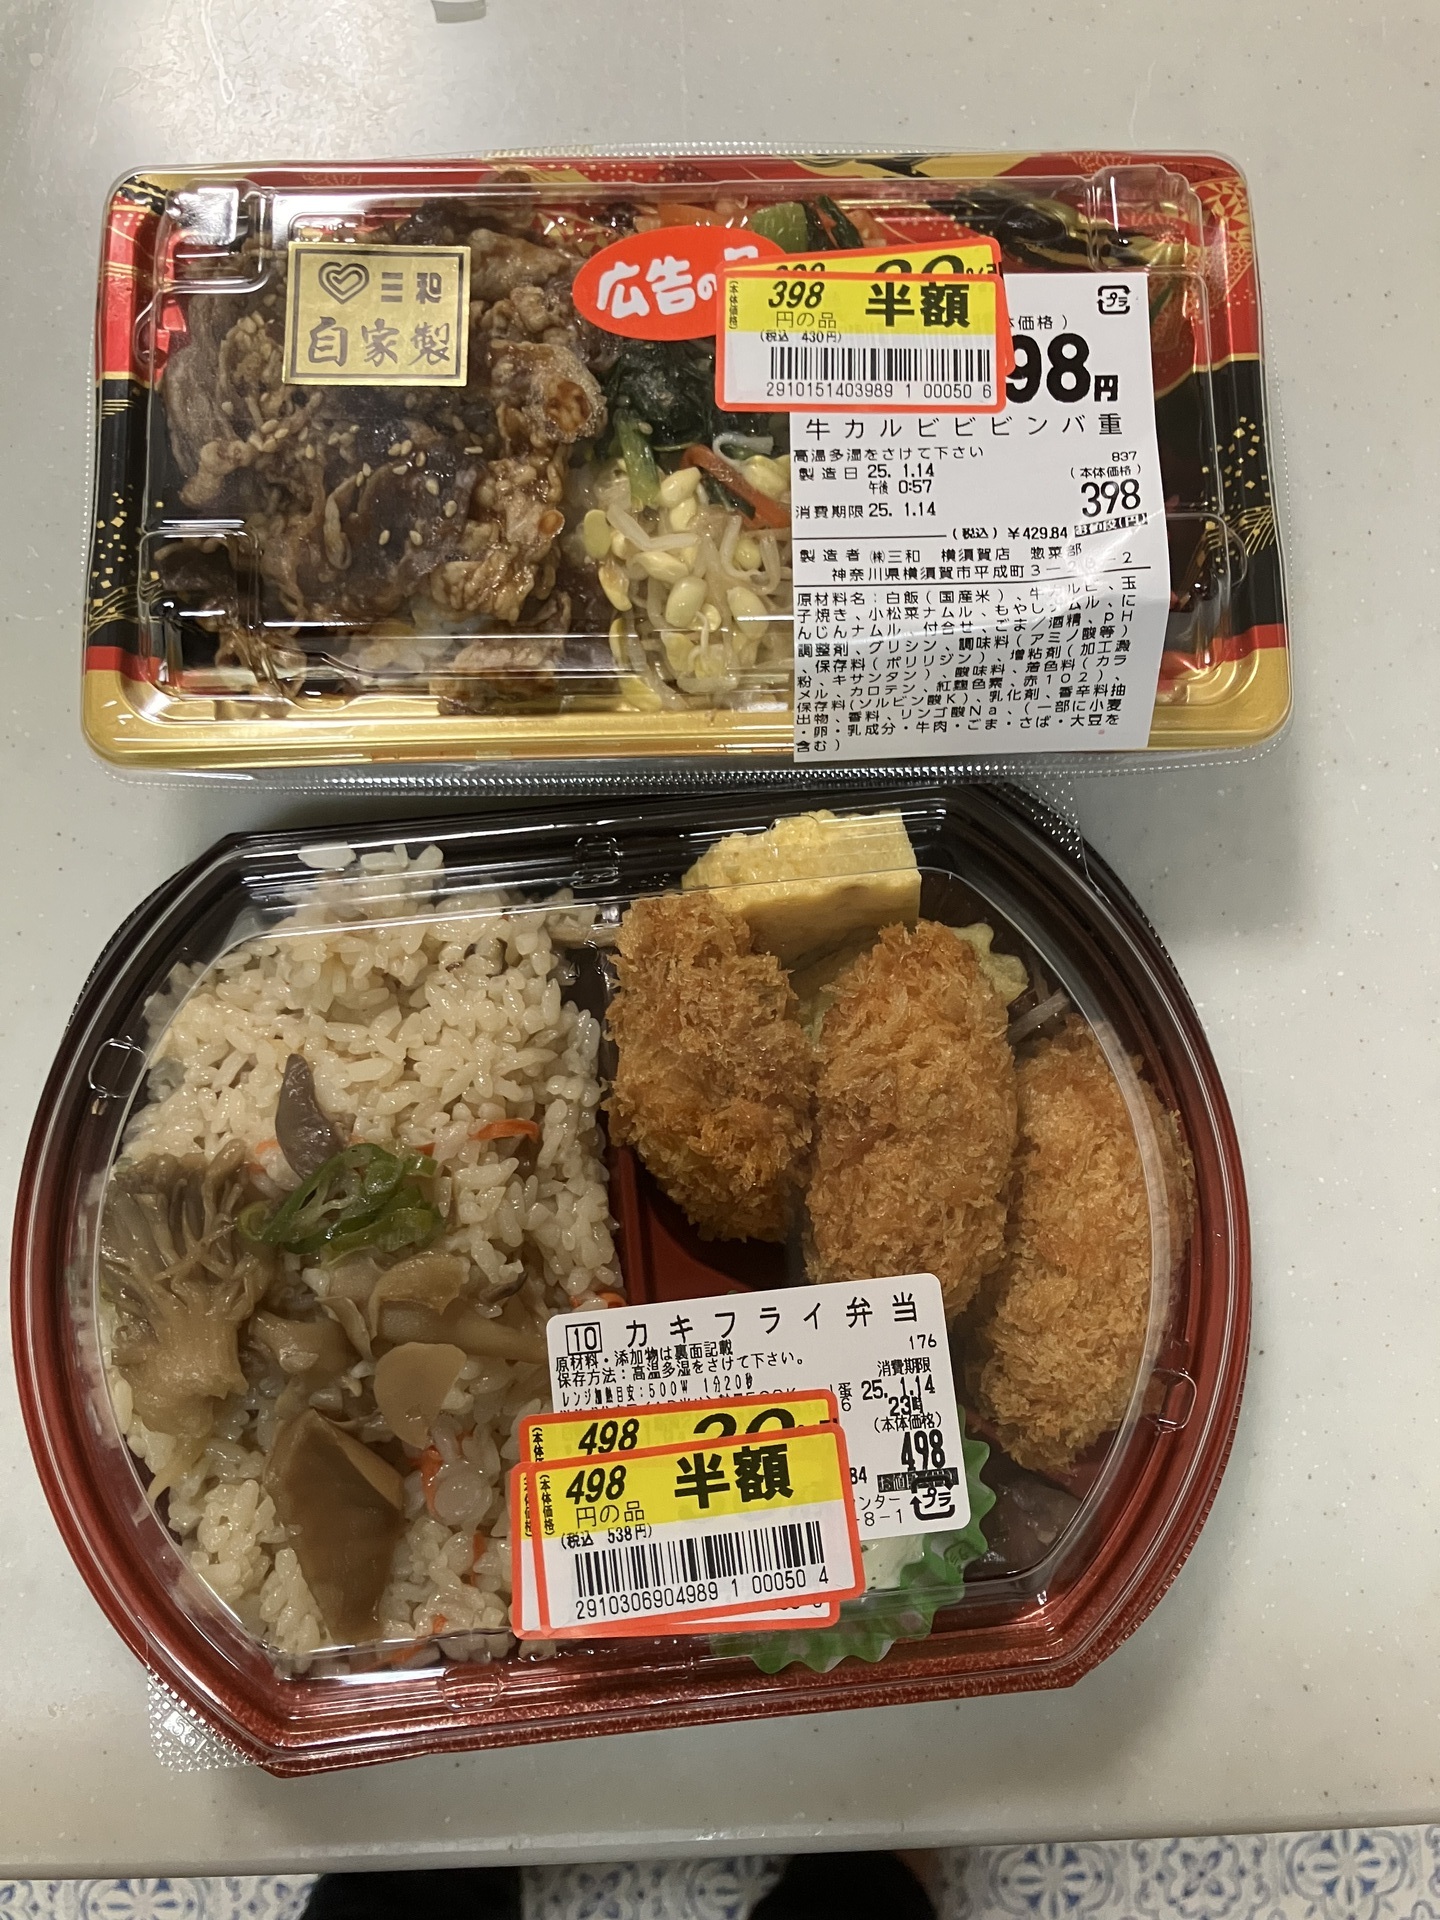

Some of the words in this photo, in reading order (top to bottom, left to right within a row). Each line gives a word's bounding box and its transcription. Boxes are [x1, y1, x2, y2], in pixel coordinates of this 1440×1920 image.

[381, 272, 442, 304] 三和
[768, 280, 825, 309] 398
[865, 281, 971, 328] 半額
[775, 311, 837, 329] 円の品
[1009, 314, 1068, 330] 価格)
[308, 316, 450, 367] 自家製
[801, 330, 842, 343] 430円)
[1006, 333, 1119, 404] 98円
[766, 382, 894, 398] 2910151403989
[923, 384, 972, 398] 00050
[983, 384, 992, 398] 6
[806, 412, 1123, 441] 牛カルビビビンバ重
[793, 446, 984, 463] 高温多湿をさけて下さい
[1112, 450, 1138, 462] 837
[799, 467, 858, 481] 製造日
[904, 463, 935, 478] 1.14
[869, 480, 889, 495] 午後
[898, 479, 933, 494] 0:57
[1081, 478, 1142, 518] 398
[795, 504, 864, 519] 消費期限
[904, 501, 936, 517] 1.14
[799, 548, 861, 563] 製造者
[941, 548, 1010, 563] 横須賀店
[625, 1291, 918, 1348] カキフライ弁当
[909, 1333, 937, 1350] 176
[877, 1356, 932, 1378] 消費期限
[578, 1418, 640, 1456] 498
[901, 1428, 946, 1472] 498
[565, 1465, 627, 1505] 498
[674, 1443, 794, 1510] 半額
[854, 1493, 901, 1511] ンター
[576, 1500, 645, 1529] 円の品
[608, 1525, 653, 1545] 538円)
[575, 1581, 719, 1620] 2910306904989
[752, 1568, 807, 1595] 00050
[818, 1565, 829, 1585] 4
